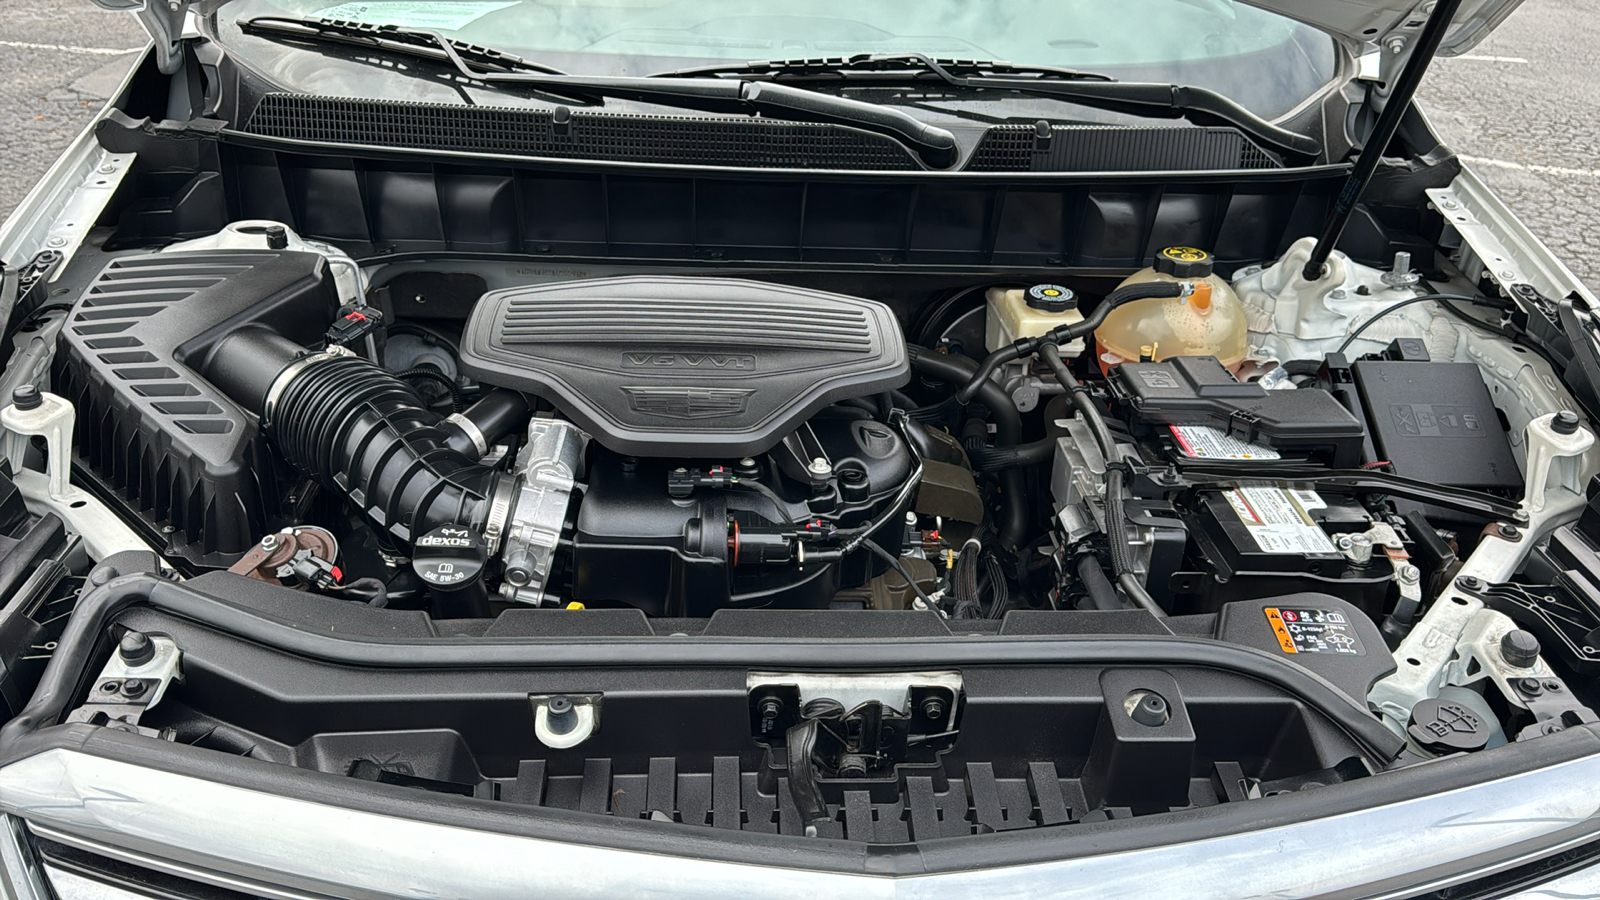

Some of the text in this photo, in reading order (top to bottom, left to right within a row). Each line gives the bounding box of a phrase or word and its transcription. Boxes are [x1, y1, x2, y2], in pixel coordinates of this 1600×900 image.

[627, 354, 751, 368] V6 VVT
[421, 535, 472, 546] dexos
[424, 570, 465, 582] SAE 5W-30
